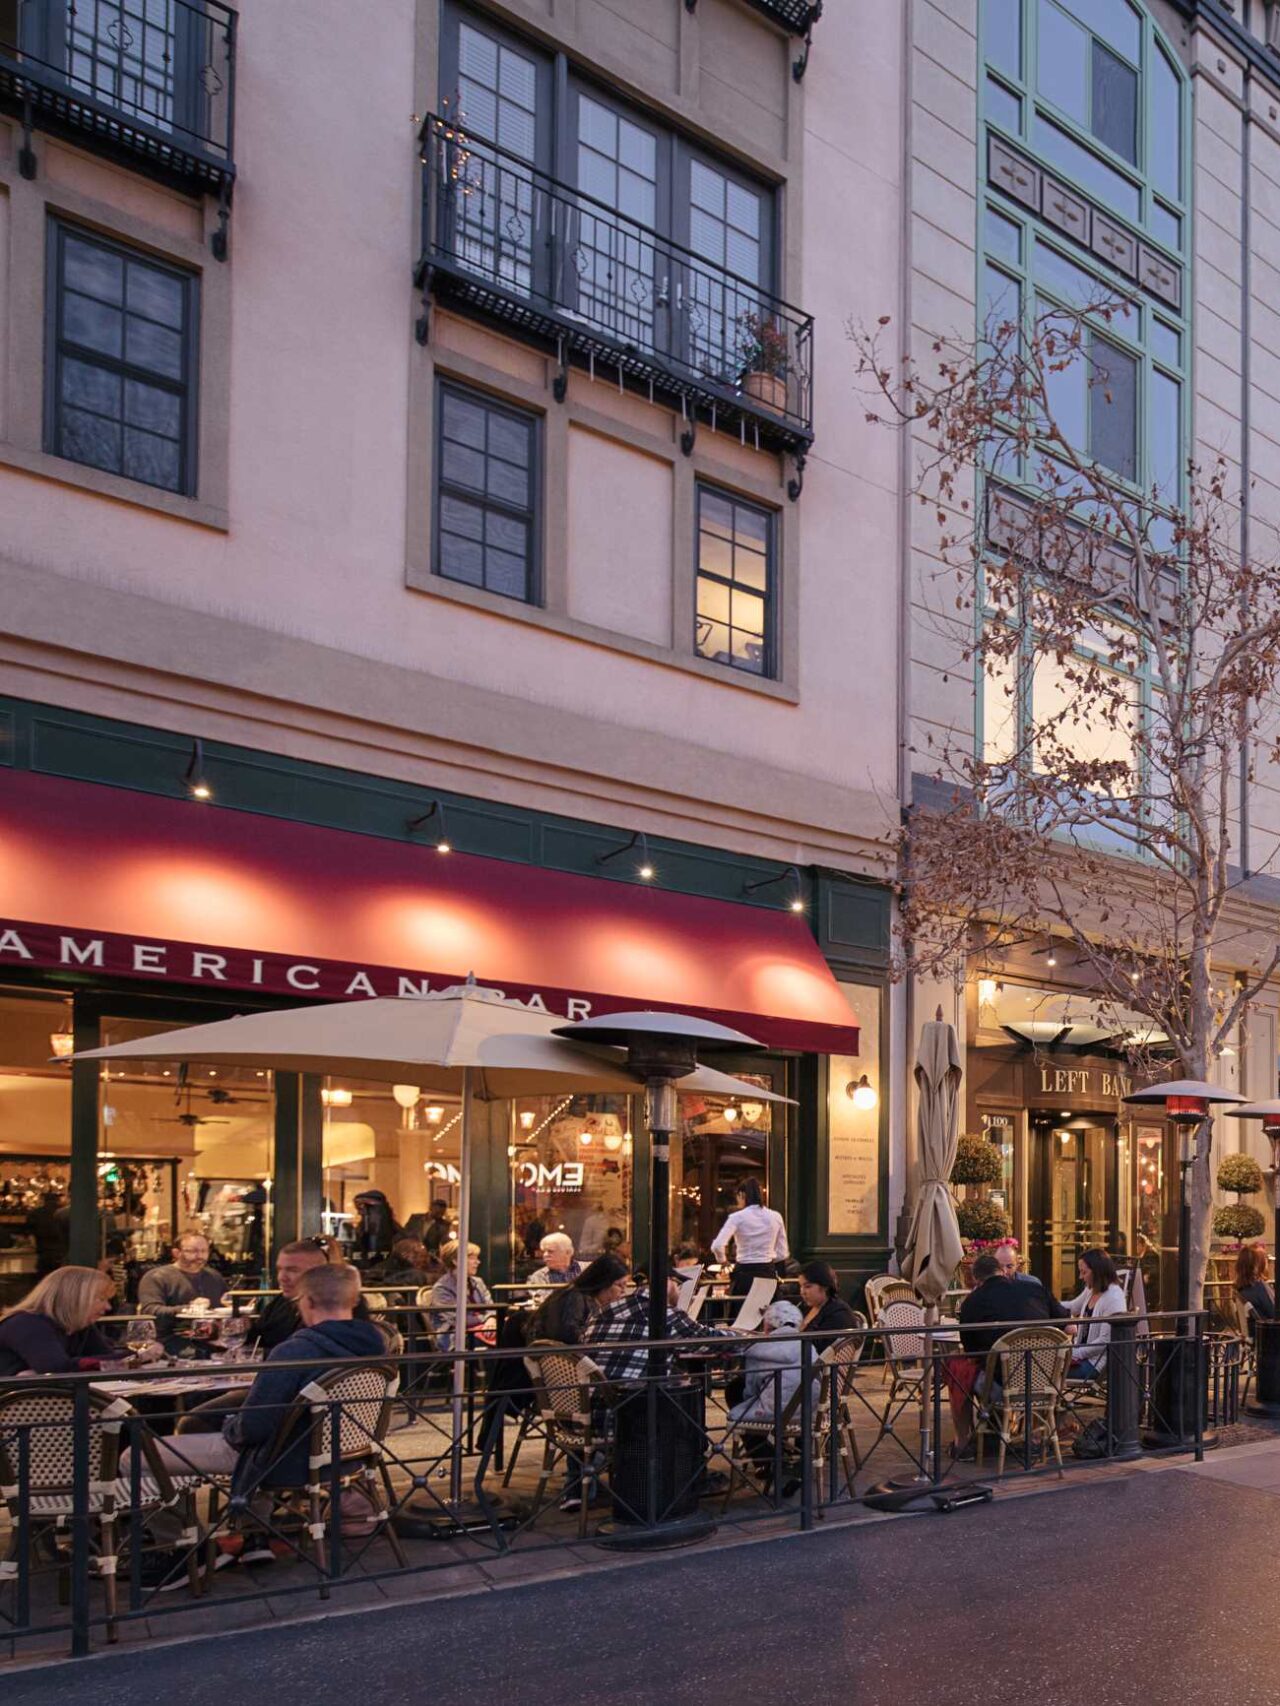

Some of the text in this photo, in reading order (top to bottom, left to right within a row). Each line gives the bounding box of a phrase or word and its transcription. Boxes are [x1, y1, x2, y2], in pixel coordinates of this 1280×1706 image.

[0, 929, 592, 1020] AMERICAN AR
[1041, 1069, 1089, 1093] LEFT
